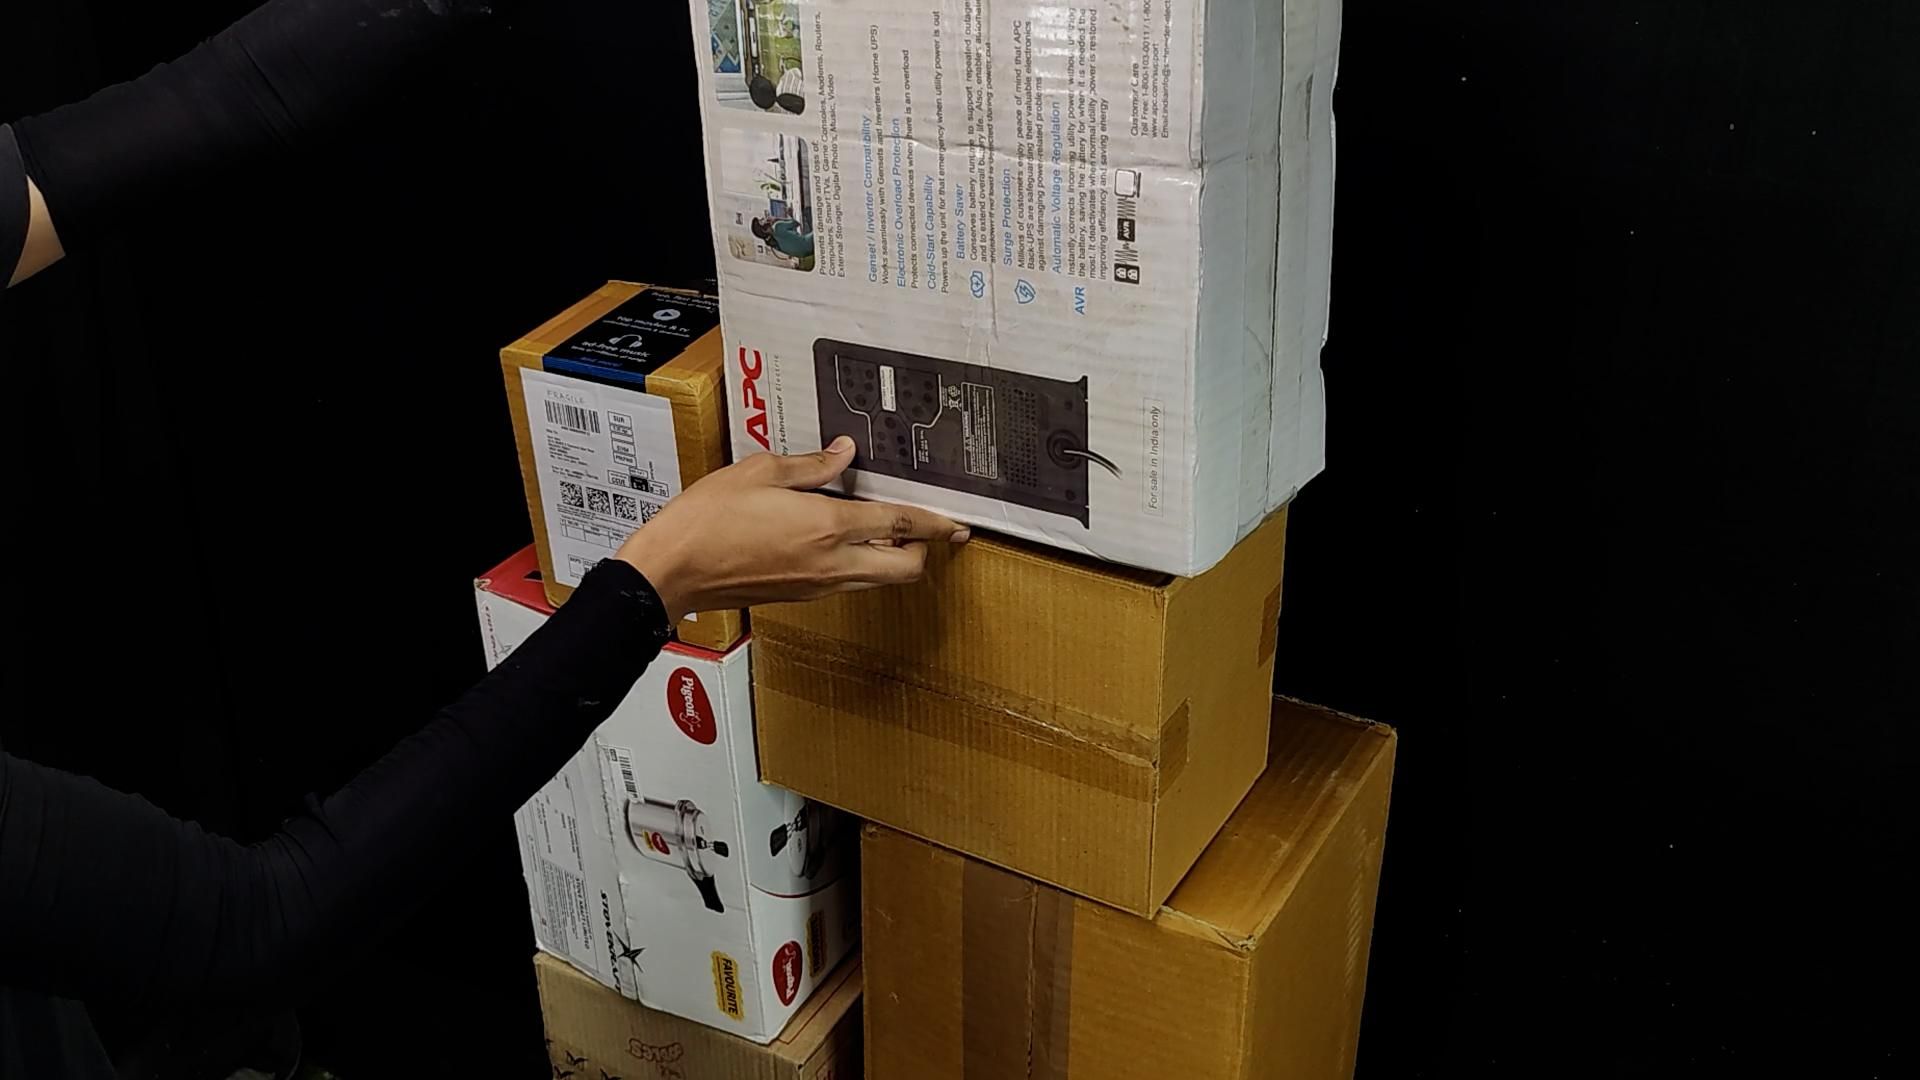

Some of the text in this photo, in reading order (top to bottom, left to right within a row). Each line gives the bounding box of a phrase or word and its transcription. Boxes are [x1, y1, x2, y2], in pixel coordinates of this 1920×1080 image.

[932, 11, 940, 26] out
[1013, 20, 1022, 43] APC
[1089, 9, 1097, 51] restored
[870, 24, 878, 50] UPS)
[1024, 21, 1032, 74] electronics
[1077, 28, 1085, 66] needed
[872, 53, 880, 84] (Home
[902, 50, 910, 90] overload
[934, 40, 942, 69] power
[1088, 54, 1096, 62] is
[934, 71, 943, 96] utility
[1014, 69, 1022, 92] mind
[1078, 70, 1085, 78] is
[874, 86, 882, 126] Inverters
[903, 106, 911, 114] is
[904, 92, 911, 104] an
[1014, 95, 1022, 106] of
[1024, 76, 1032, 117] valuable
[1035, 77, 1044, 121] problems
[1089, 97, 1097, 123] utility
[964, 0, 978, 260] Conserves battery runtme to support repeated outage
[1016, 110, 1024, 138] peace
[1025, 120, 1033, 140] their
[1100, 98, 1109, 132] energy
[1141, 122, 1149, 136] Toll
[875, 128, 883, 146] and
[937, 125, 946, 176] emergency
[1067, 122, 1076, 147] utility
[1099, 135, 1108, 166] saving
[812, 155, 820, 173] loss
[822, 145, 830, 172] Game
[876, 148, 885, 184] Gensets
[906, 142, 914, 166] when
[1016, 142, 1025, 167] enjoy
[832, 172, 841, 200] Digital
[906, 170, 915, 203] devices
[937, 178, 945, 195] that
[977, 168, 986, 199] overall
[1016, 171, 1024, 218] customers
[1051, 102, 1063, 274] Automatic Voltage Regulation
[816, 196, 824, 232] damage
[824, 198, 832, 224] Smart
[865, 192, 875, 234] Inverter
[892, 180, 904, 230] Overload
[938, 198, 946, 210] for
[938, 212, 946, 228] unit
[978, 201, 986, 232] extend
[1002, 168, 1014, 266] Surge Protection
[1036, 191, 1045, 236] damaging
[1067, 196, 1075, 234] corrects
[1078, 192, 1087, 222] saving
[1088, 189, 1096, 242] deactivates
[1099, 189, 1108, 232] efficiency
[879, 207, 888, 255] seamlessly
[908, 206, 916, 251] connected
[922, 175, 936, 290] Cold-Start Capability
[940, 231, 948, 245] the
[954, 184, 966, 259] Battery Saver
[1016, 222, 1024, 231] of
[941, 248, 949, 258] up
[979, 234, 986, 243] to
[1017, 234, 1025, 268] Millions
[1026, 222, 1035, 270] Back-UPS
[1036, 238, 1046, 271] against
[836, 242, 845, 278] External
[867, 243, 877, 282] Genset
[880, 258, 888, 284] Works
[895, 234, 906, 288] Electronic
[910, 254, 918, 288] Protects
[1078, 262, 1086, 277] the
[1099, 235, 1108, 280] improving
[940, 261, 949, 294] Powers
[1075, 287, 1085, 315] AVR
[739, 346, 770, 451] APC
[774, 354, 788, 456] by Schneider Electric
[1149, 406, 1160, 509] For sale in India only
[680, 676, 696, 717] Pigeon
[722, 958, 738, 1015] FAVOURITE
